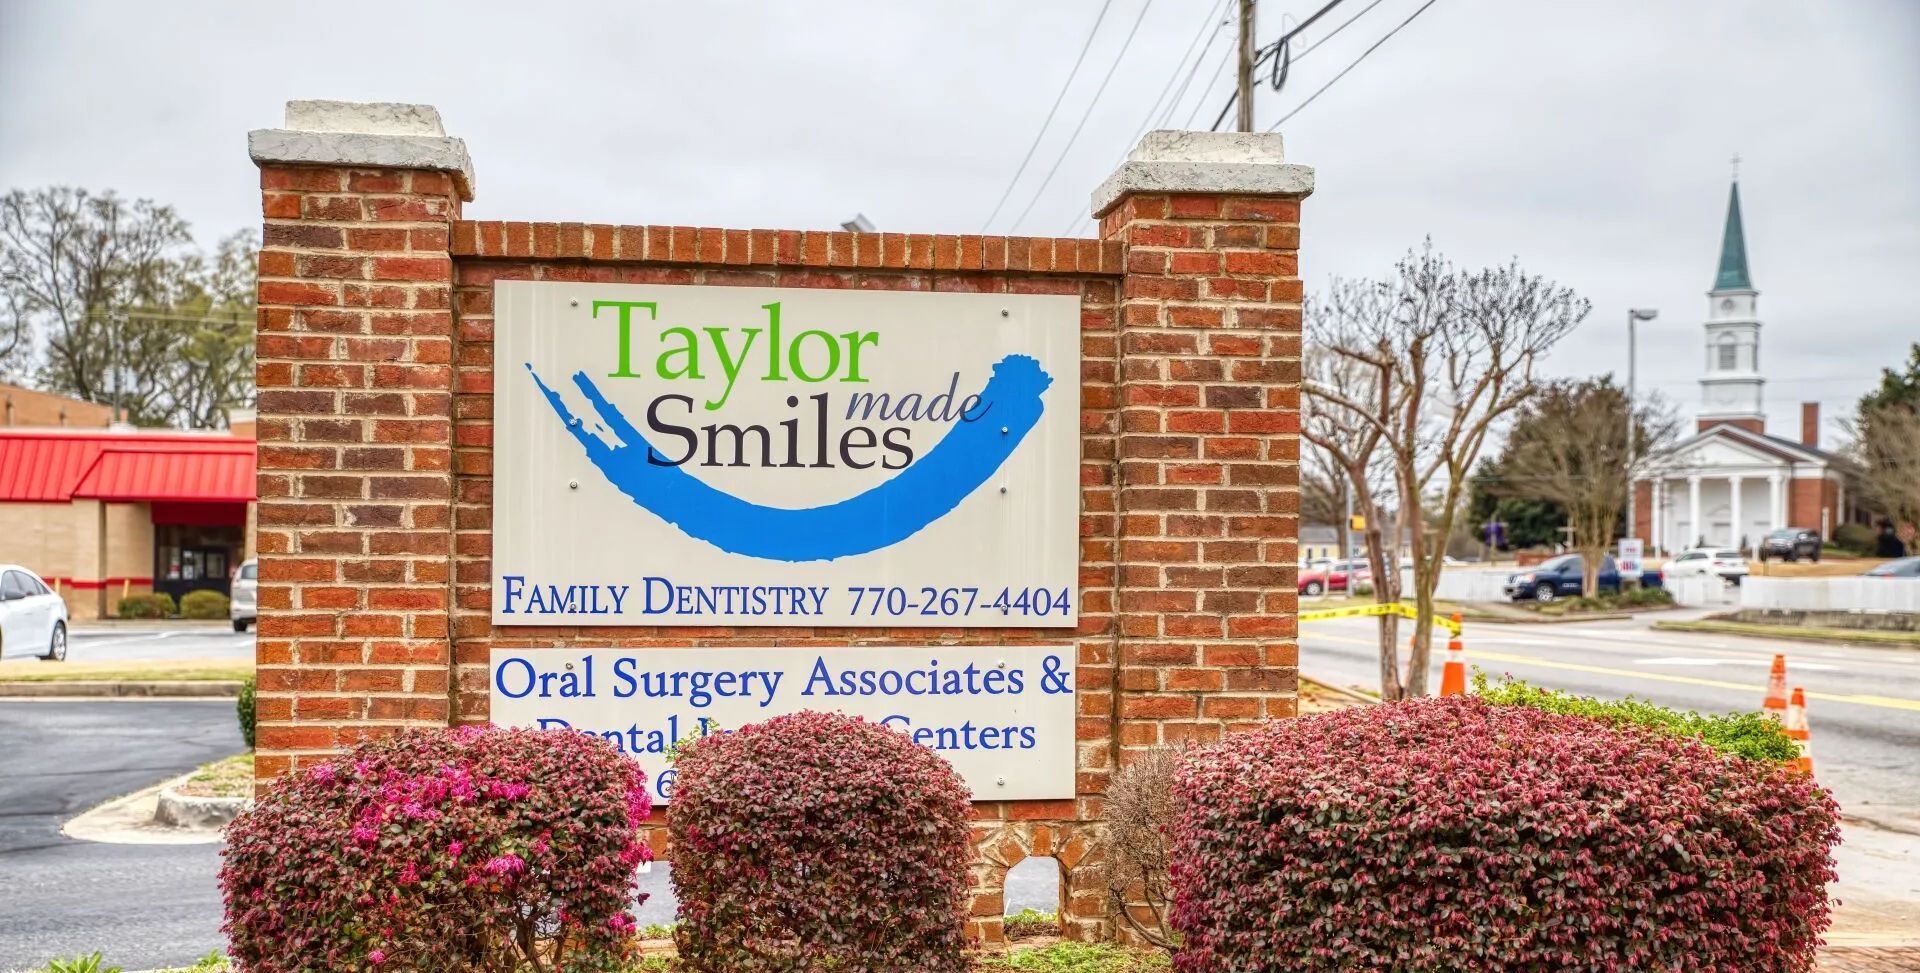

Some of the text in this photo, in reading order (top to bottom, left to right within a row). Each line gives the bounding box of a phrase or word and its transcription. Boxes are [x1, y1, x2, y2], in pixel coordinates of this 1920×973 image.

[592, 301, 879, 411] Taylor
[845, 372, 992, 424] made
[646, 394, 914, 470] Smiles
[502, 575, 1071, 617] FAMILY DENTISTRY 770-267-4404
[495, 655, 1073, 707] Oral Surgery Associates &
[537, 714, 678, 753] ntal
